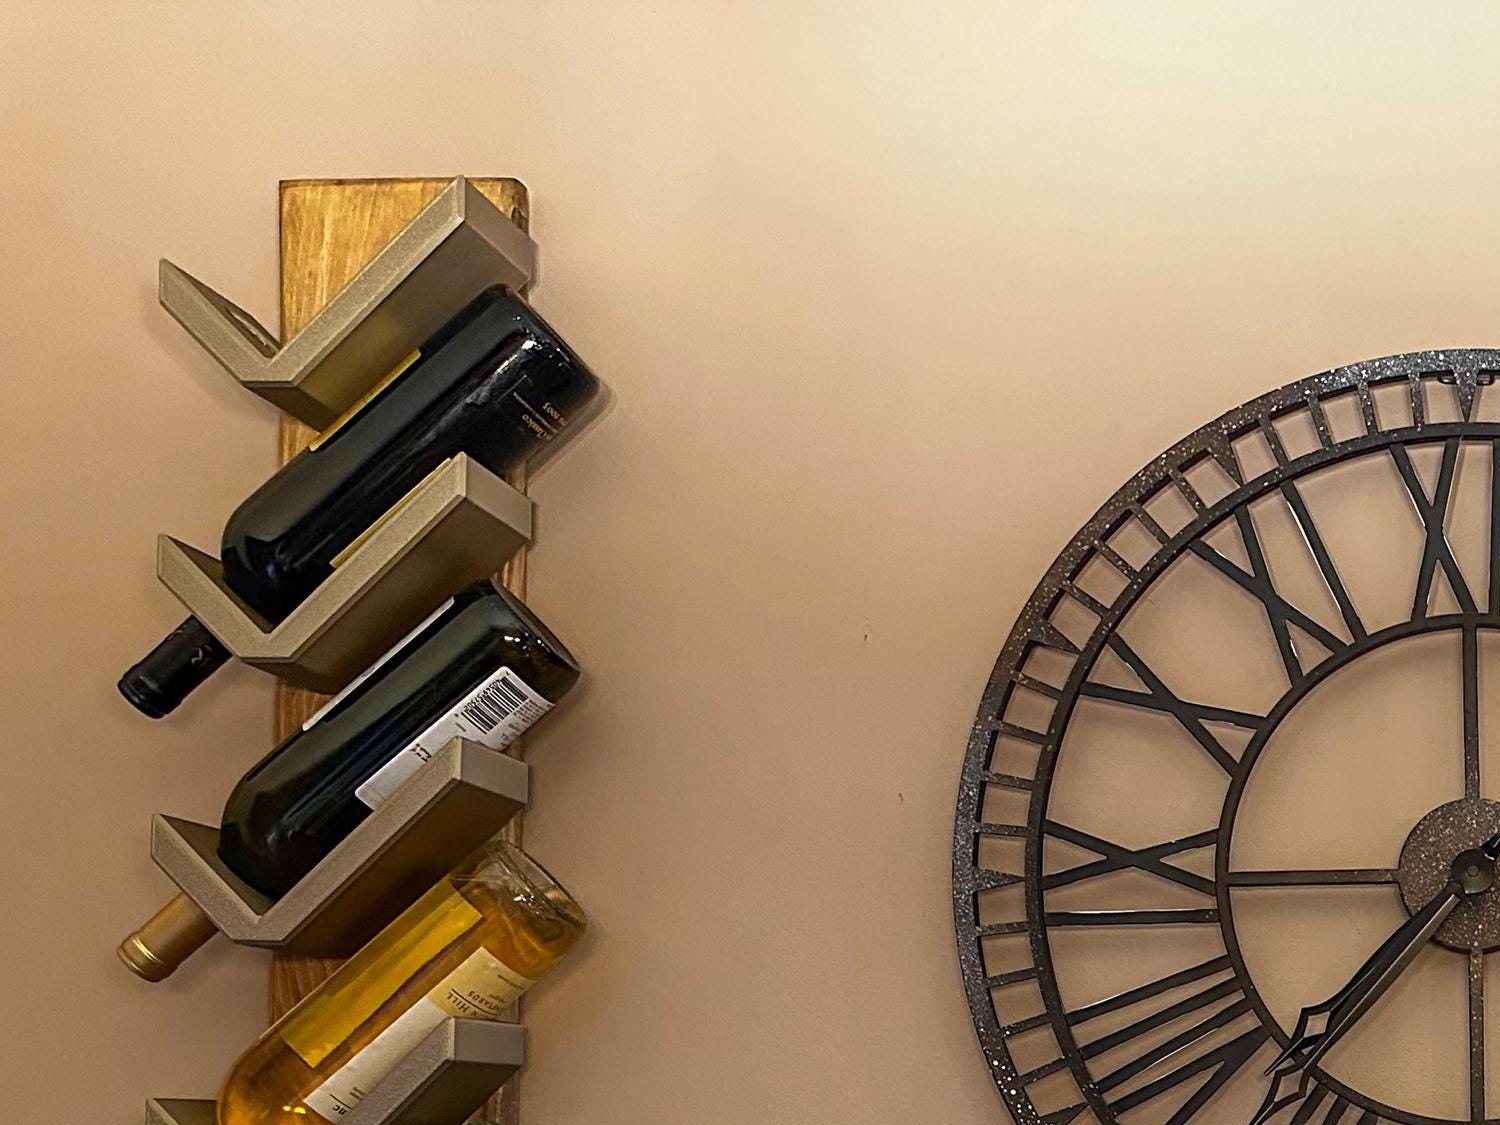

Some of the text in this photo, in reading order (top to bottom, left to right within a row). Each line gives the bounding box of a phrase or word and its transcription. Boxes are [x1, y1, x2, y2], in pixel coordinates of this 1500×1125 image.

[1188, 480, 1366, 687] XI
[1080, 631, 1265, 777] X
[1043, 820, 1218, 923] IX
